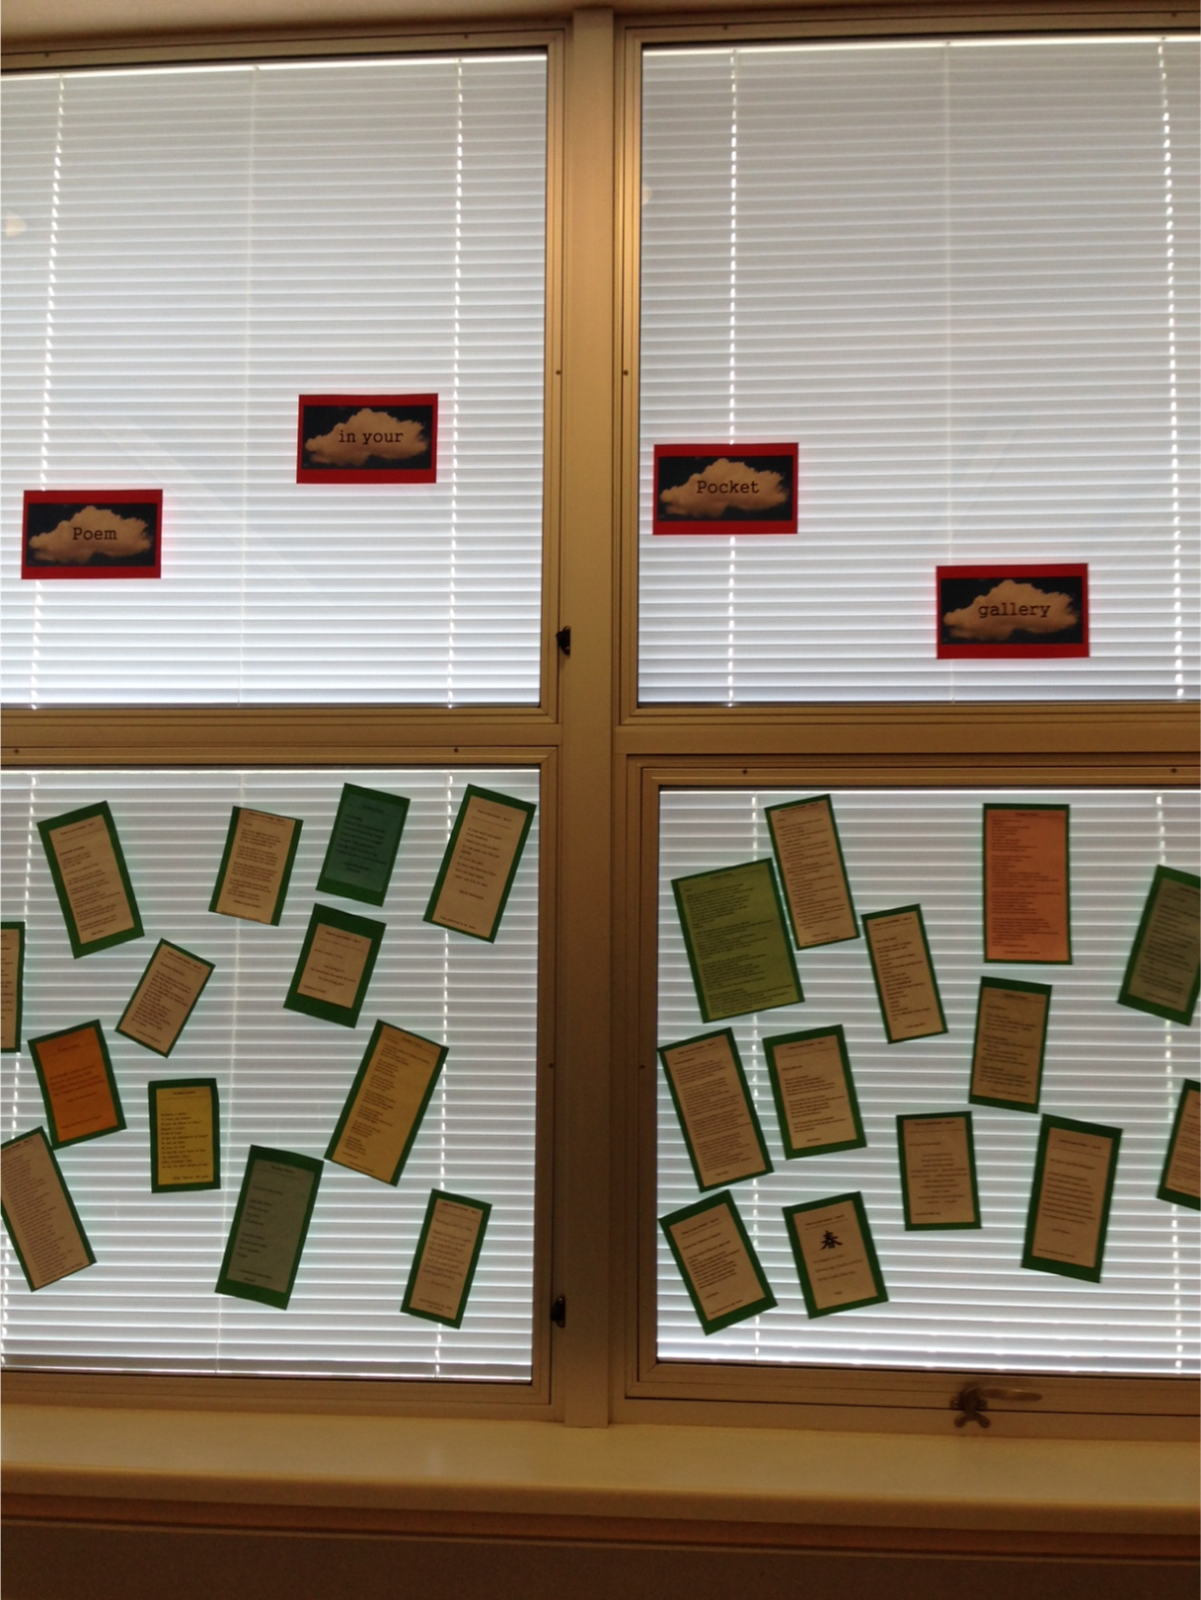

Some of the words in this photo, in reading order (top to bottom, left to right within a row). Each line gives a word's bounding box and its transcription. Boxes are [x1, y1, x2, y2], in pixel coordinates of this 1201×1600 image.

[338, 429, 356, 443] in
[362, 432, 404, 445] your
[696, 480, 760, 494] Pocket
[72, 526, 118, 541] Poem
[978, 601, 1052, 619] gallery
